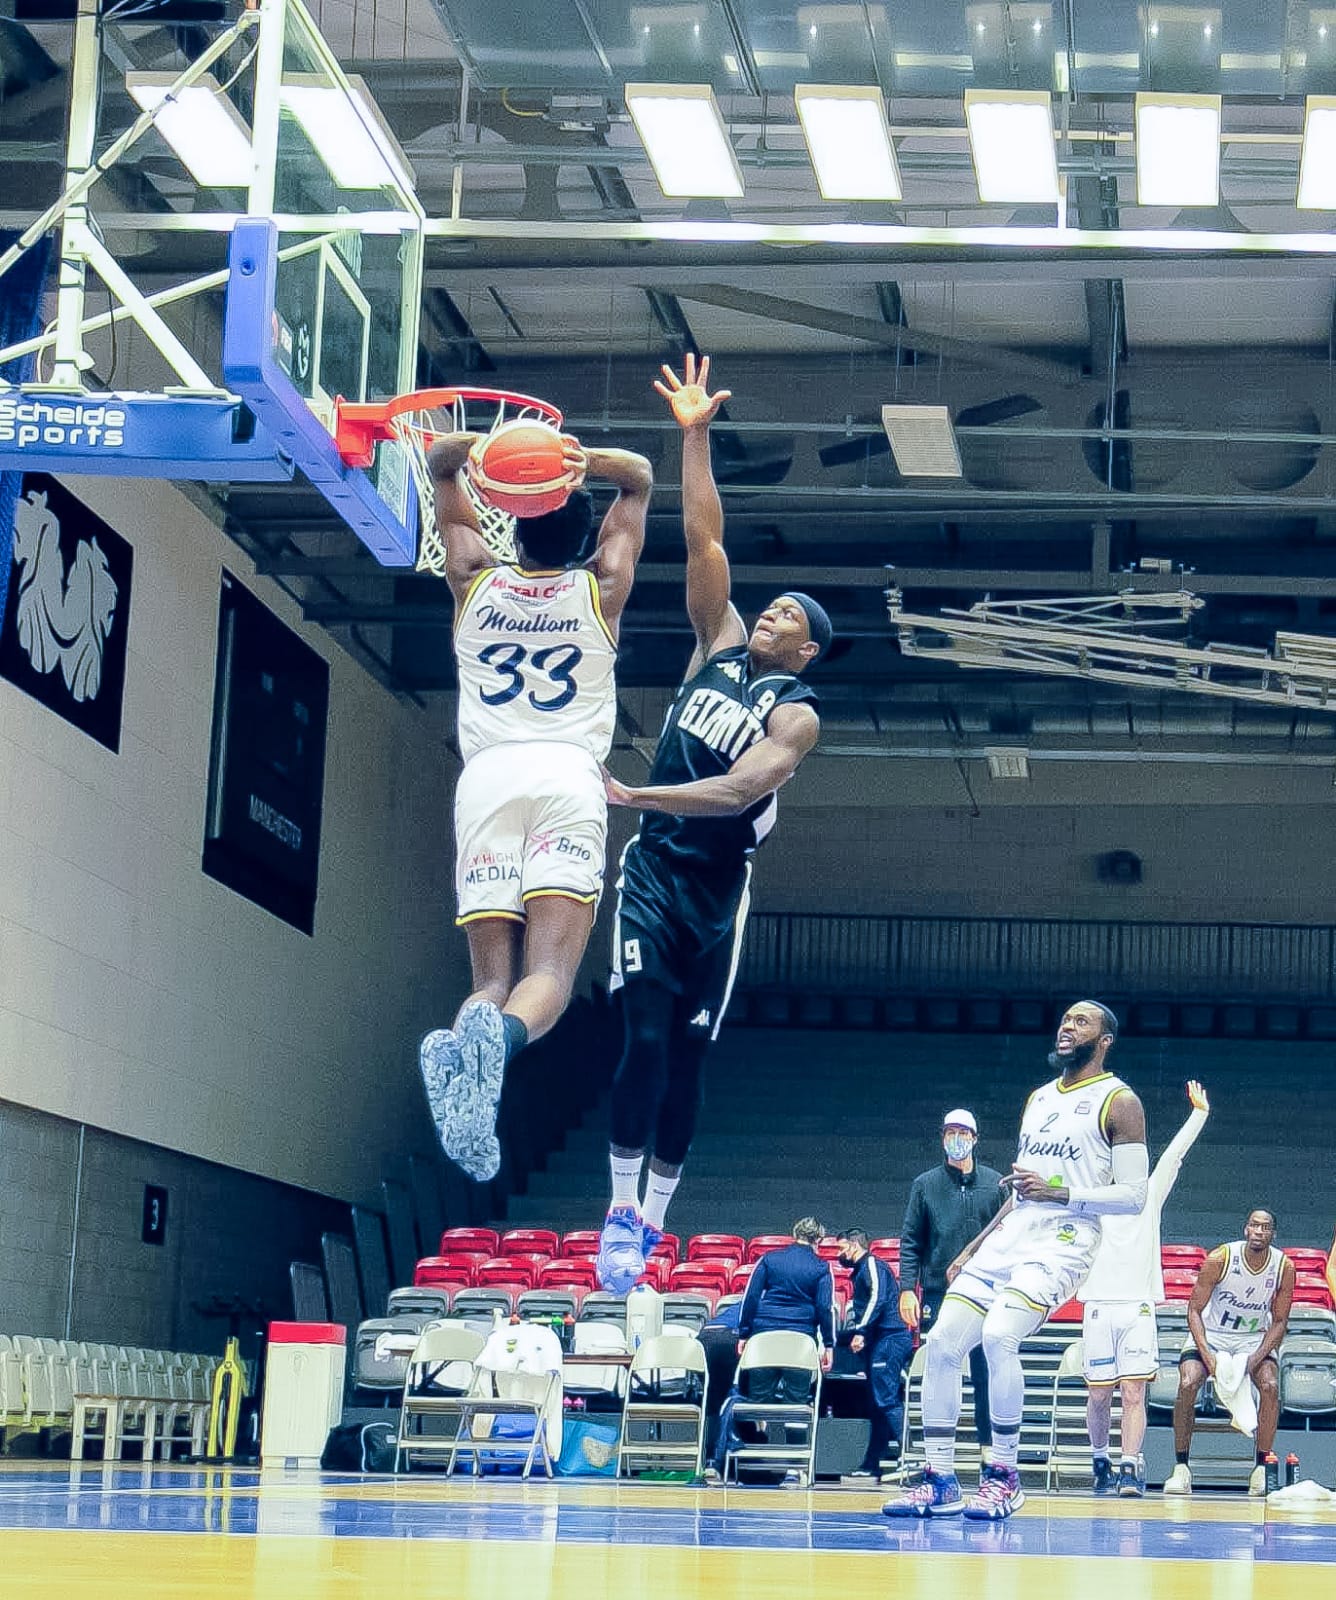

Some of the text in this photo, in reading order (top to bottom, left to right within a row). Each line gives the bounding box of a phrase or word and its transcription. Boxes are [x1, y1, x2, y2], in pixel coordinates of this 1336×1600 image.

[0, 399, 125, 427] Schelde
[0, 420, 124, 448] Sports
[476, 605, 581, 634] Mouliom
[477, 642, 583, 712] 33
[752, 689, 776, 720] 9
[556, 836, 591, 861] Brio
[464, 865, 521, 887] MEDIA
[624, 939, 642, 972] 9
[1039, 1112, 1060, 1133] 2
